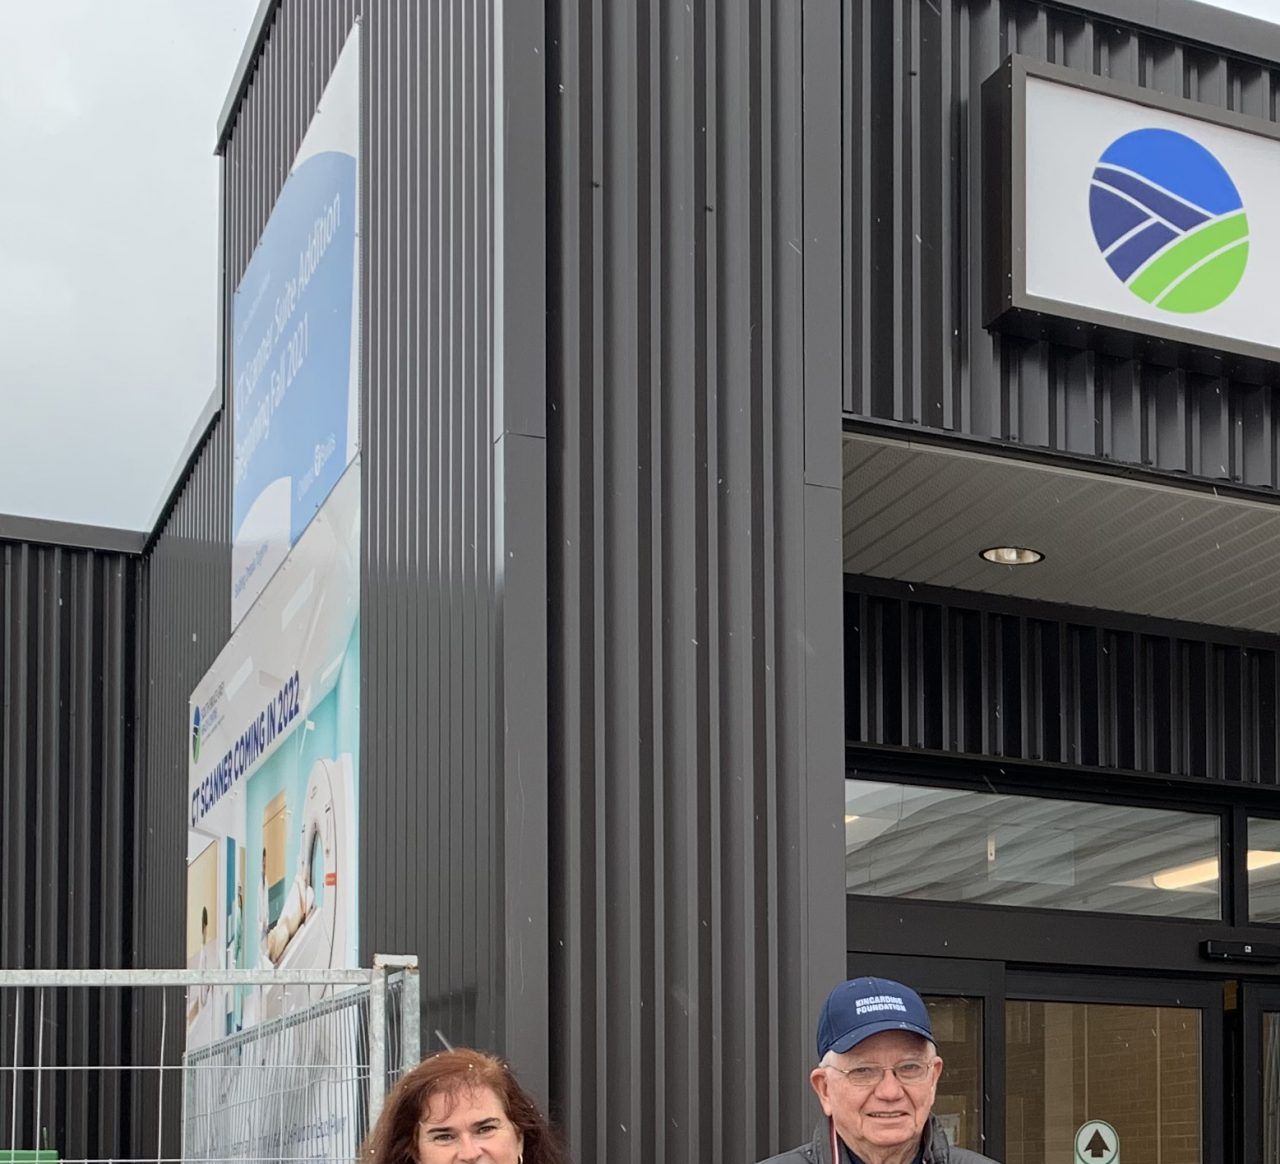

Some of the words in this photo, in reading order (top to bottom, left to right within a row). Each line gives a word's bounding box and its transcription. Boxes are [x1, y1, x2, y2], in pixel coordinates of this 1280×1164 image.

[275, 278, 297, 344] Suite
[298, 192, 340, 301] Addition
[271, 349, 286, 416] Fall
[287, 311, 308, 388] 2021
[191, 787, 200, 828] CT
[201, 750, 233, 818] SCANNER
[233, 711, 265, 782] COMING
[267, 697, 277, 747] IN
[278, 670, 300, 734] 2022
[856, 1003, 907, 1015] FOUNDATION
